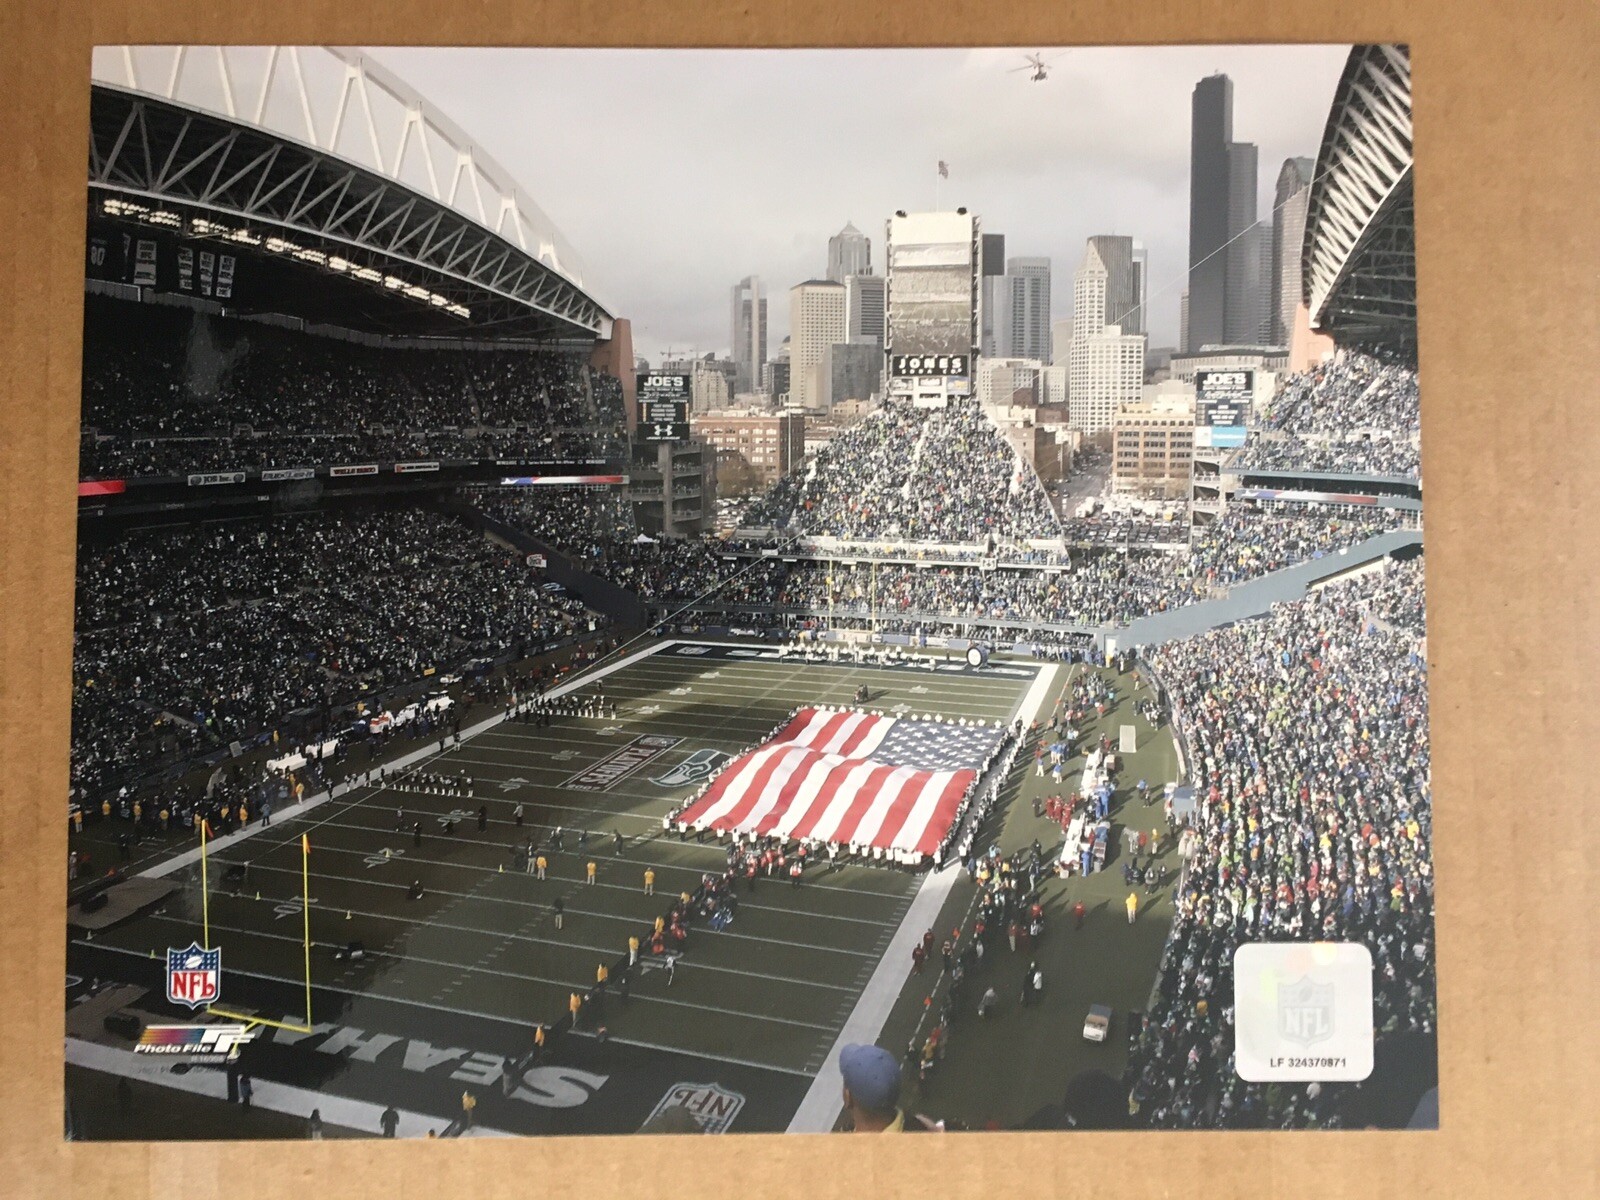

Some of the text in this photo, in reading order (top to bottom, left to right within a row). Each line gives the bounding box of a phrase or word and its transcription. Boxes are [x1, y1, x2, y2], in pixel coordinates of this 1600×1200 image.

[899, 357, 962, 369] JONES
[644, 376, 684, 387] JOE'S
[171, 971, 216, 1000] NFL
[1283, 1007, 1328, 1038] NFL
[133, 1043, 212, 1053] Photo File
[1270, 1057, 1346, 1068] LF 324370871
